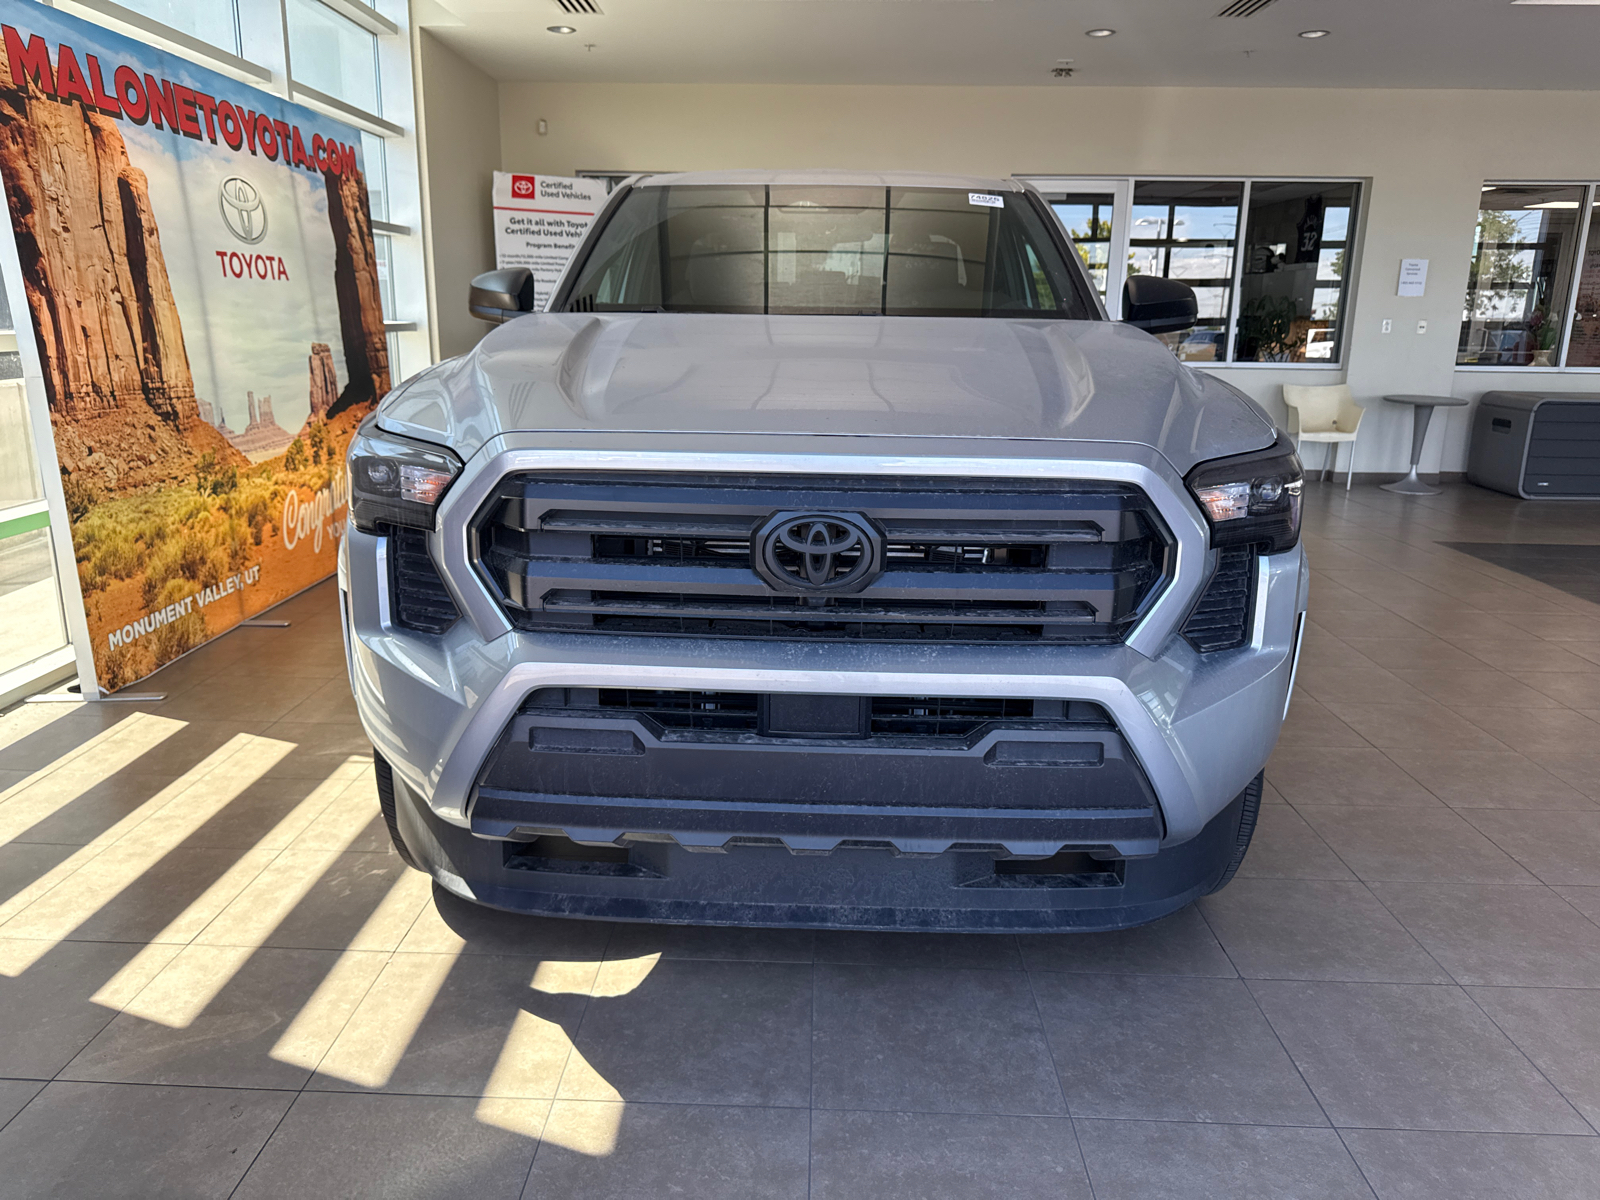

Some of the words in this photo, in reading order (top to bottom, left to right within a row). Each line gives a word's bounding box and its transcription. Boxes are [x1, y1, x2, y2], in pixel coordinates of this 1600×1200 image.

[2, 24, 358, 180] MALONETOYOTA.COM
[540, 181, 573, 190] Certified
[540, 190, 560, 198] Used
[561, 191, 591, 201] Vehicles
[509, 217, 525, 226] Get
[526, 218, 533, 226] it
[534, 218, 546, 227] all
[546, 219, 565, 228] with
[505, 226, 541, 237] Certified
[543, 229, 563, 237] Used
[526, 241, 552, 250] Program
[1301, 231, 1317, 251] 32
[215, 250, 290, 281] TOYOTA
[108, 596, 193, 651] MONUMENT
[195, 573, 244, 608] VALLEY,
[245, 565, 260, 585] UT
